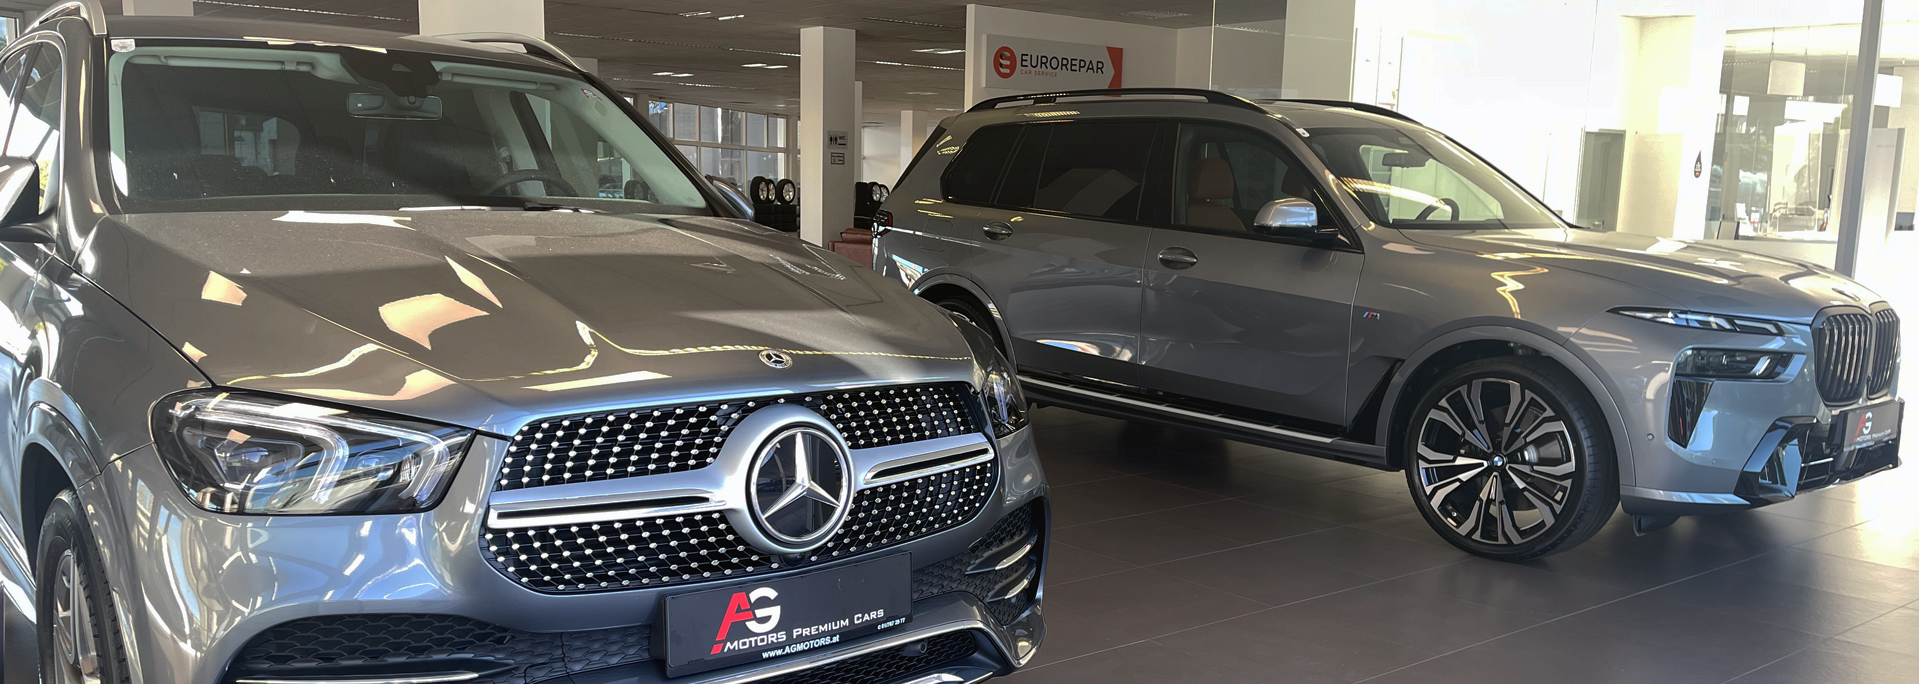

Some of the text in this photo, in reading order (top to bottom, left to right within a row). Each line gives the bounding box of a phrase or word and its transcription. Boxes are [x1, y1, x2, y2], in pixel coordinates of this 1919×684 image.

[1020, 53, 1105, 75] EUROREPAR
[1034, 70, 1058, 78] SERVICE
[1854, 411, 1873, 436] AG
[712, 586, 781, 642] AG
[723, 630, 787, 653] MOTORS
[761, 634, 840, 659] www.AGMOTORS.at
